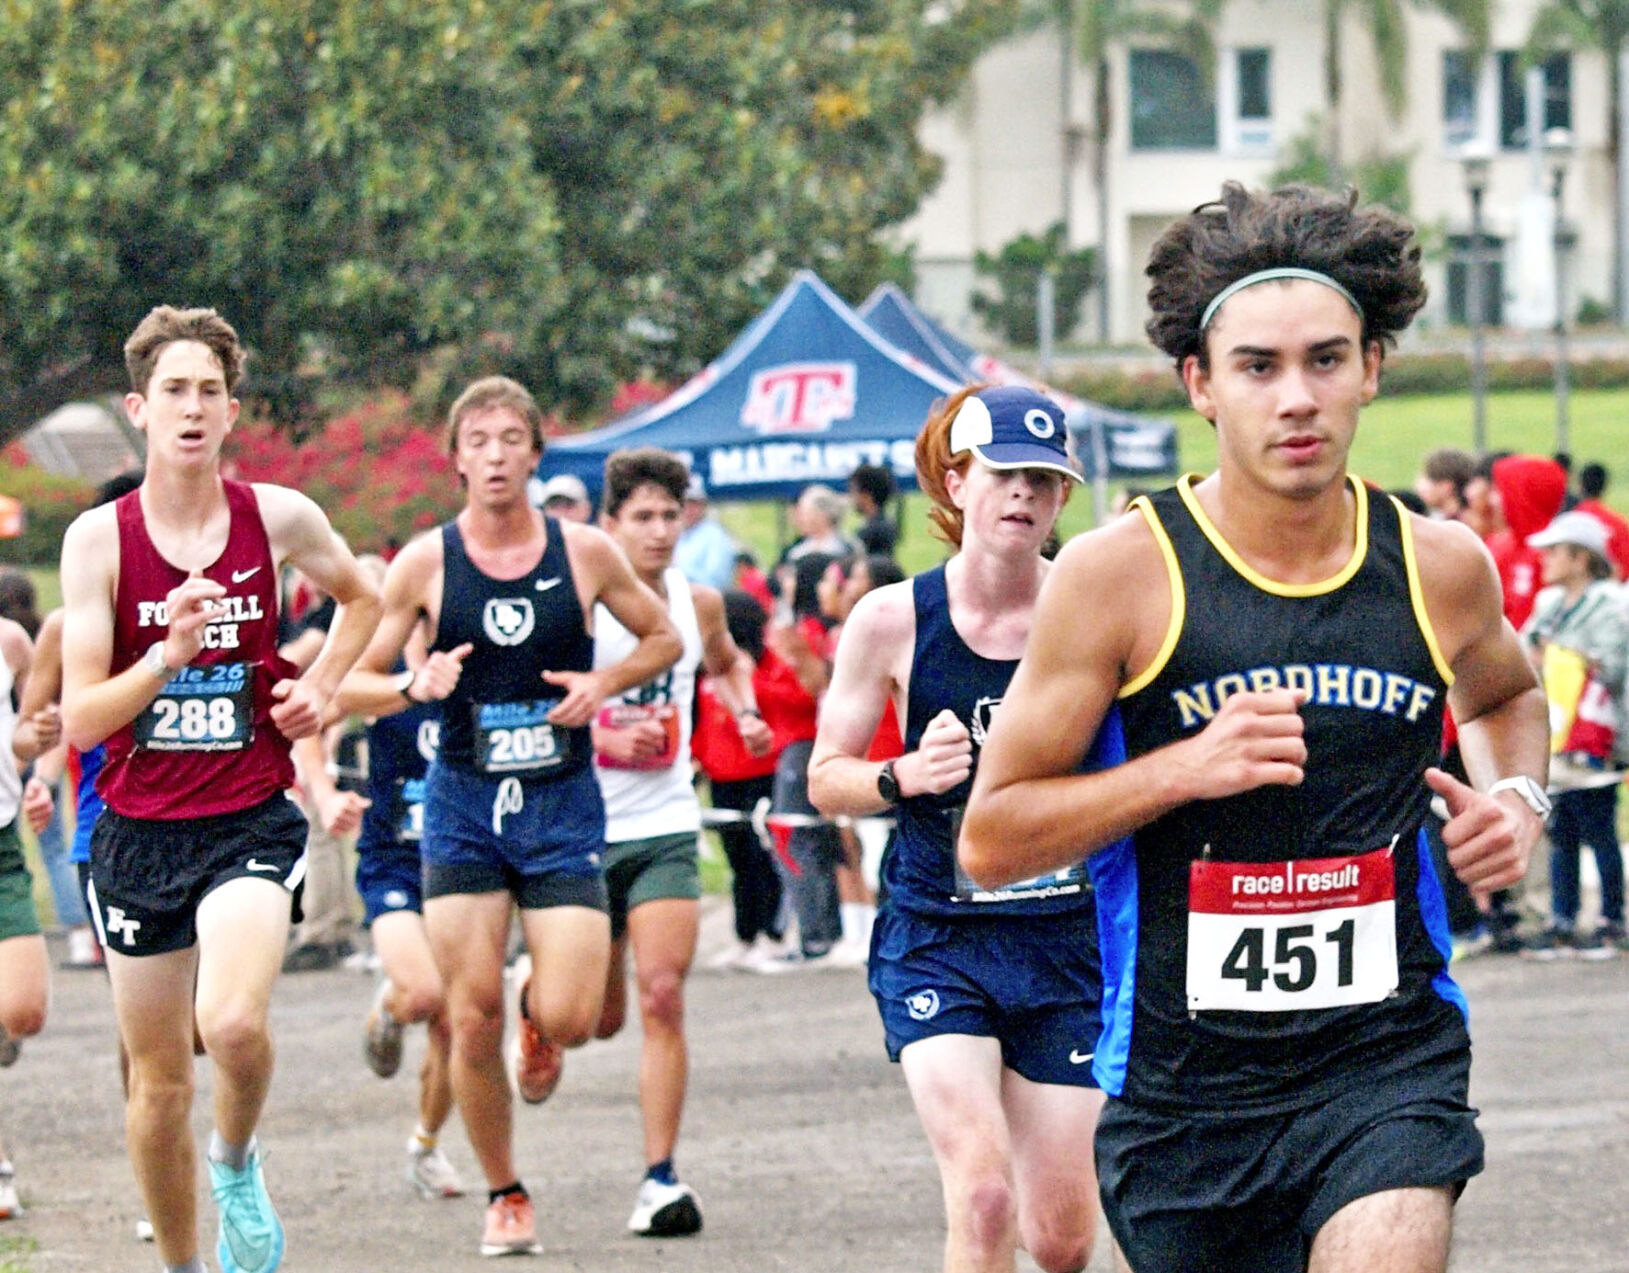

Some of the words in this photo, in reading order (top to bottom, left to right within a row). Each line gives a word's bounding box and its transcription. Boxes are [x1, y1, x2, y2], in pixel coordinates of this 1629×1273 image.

[138, 595, 263, 627] FOHILL
[211, 663, 245, 682] 26
[1170, 663, 1437, 728] NORDHOFF
[152, 697, 236, 739] 288
[489, 725, 556, 763] 205
[107, 905, 141, 945] FT
[1221, 919, 1355, 993] 451
